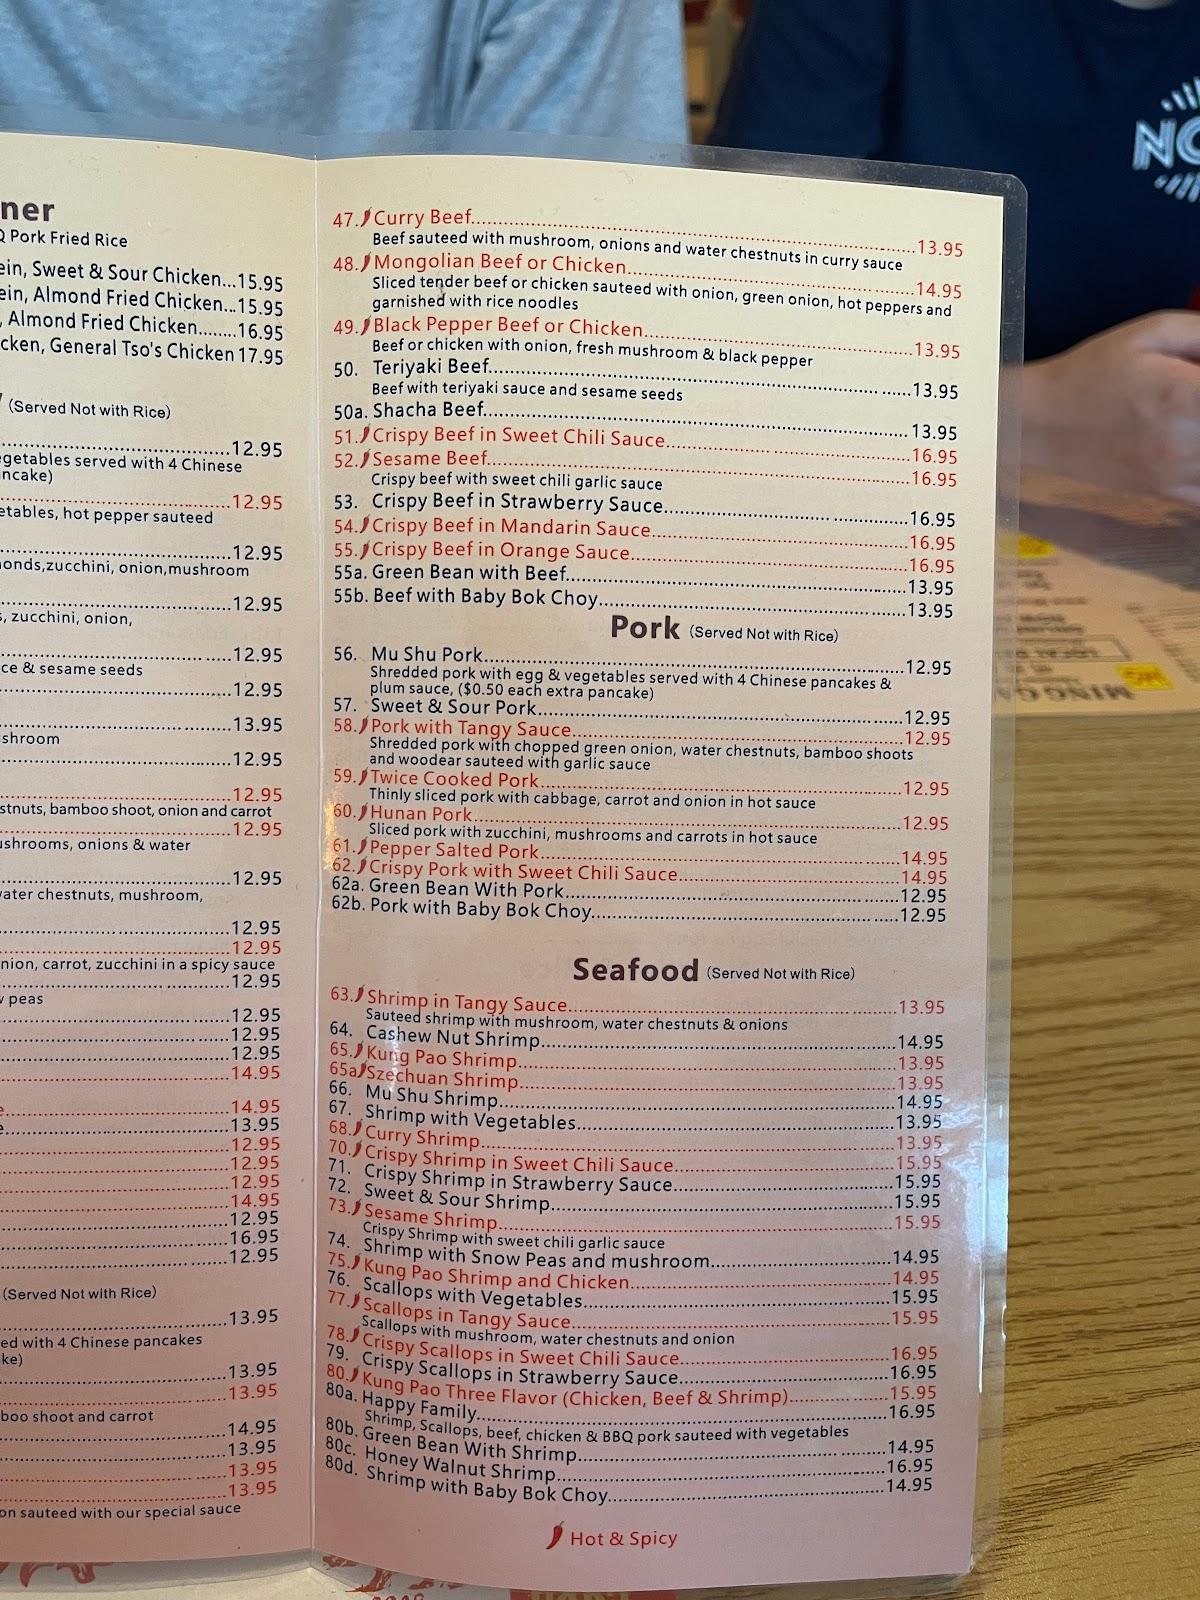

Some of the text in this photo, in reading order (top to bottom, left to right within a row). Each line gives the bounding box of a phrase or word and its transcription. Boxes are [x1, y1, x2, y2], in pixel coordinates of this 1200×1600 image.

[10, 228, 128, 248] Pork Fried Rice
[374, 209, 425, 230] Curry
[918, 239, 963, 258] 13.95
[373, 230, 903, 271] Beef sauteed with mushroom, onions and water chestnuts in curry sauce
[32, 260, 85, 279] Sweet
[88, 262, 104, 280] &
[108, 263, 149, 282] Sour
[237, 272, 284, 293] 15.95
[374, 252, 474, 273] Mongolian
[480, 253, 523, 269] Beef
[527, 258, 548, 270] or
[916, 281, 962, 299] 14.95
[33, 285, 101, 305] Almond
[106, 288, 149, 308] Fried
[238, 297, 283, 317] 15.95
[372, 274, 952, 317] Sliced tender beef or chicken sauteed with onion, green onion, hot peppers and
[372, 293, 579, 313] garnished with rice noodles
[7, 309, 76, 329] Almond
[81, 312, 124, 331] Fried
[238, 322, 283, 342] 16.95
[49, 336, 117, 356] General
[121, 339, 162, 358] Tso's
[166, 341, 235, 362] Chicken
[238, 346, 284, 366] 17.95
[372, 357, 442, 379] Teriyaki
[913, 382, 959, 400] 13.95
[372, 379, 683, 402] Beef with teriyaki sauce and sesame seeds
[8, 398, 171, 420] (Served Not with Rice)
[232, 440, 283, 458] 12.95
[74, 454, 243, 473] served with 4 Chinese
[63, 506, 213, 525] hot pepper sauteed
[611, 614, 839, 644] Pork (Served Not with Rice)
[372, 646, 398, 662] Mu
[403, 645, 436, 662] Shu
[906, 659, 952, 676] 12.95
[370, 680, 654, 702] plum sauce, ($0.50 each extra pancake)
[233, 787, 282, 803] 12.95
[50, 801, 272, 818] bamboo shoot, onion and carrot
[42, 957, 276, 974] carrot, zucchini in a spicy sauce
[573, 956, 855, 983] Seafood (Served Not with Rice)
[232, 973, 281, 989] 12.95
[229, 1308, 278, 1326] 13.95
[21, 1333, 203, 1351] with 4 Chinese pancakes
[362, 1371, 404, 1396] Kung
[409, 1379, 441, 1397] Pao
[445, 1383, 496, 1403] Three
[501, 1388, 558, 1406] Flavor
[562, 1390, 647, 1409] (Chicken,
[653, 1389, 693, 1406] Beef
[697, 1390, 713, 1406] &
[890, 1385, 937, 1401] 15.95
[364, 1409, 849, 1446] Shrimp, Scallops, beef, chicken & BBQ pork sauteed with vegetables
[228, 1479, 277, 1498] 13.95
[20, 1504, 241, 1521] sauteed with our special sauce
[570, 1530, 678, 1550] Hot & Spicy
